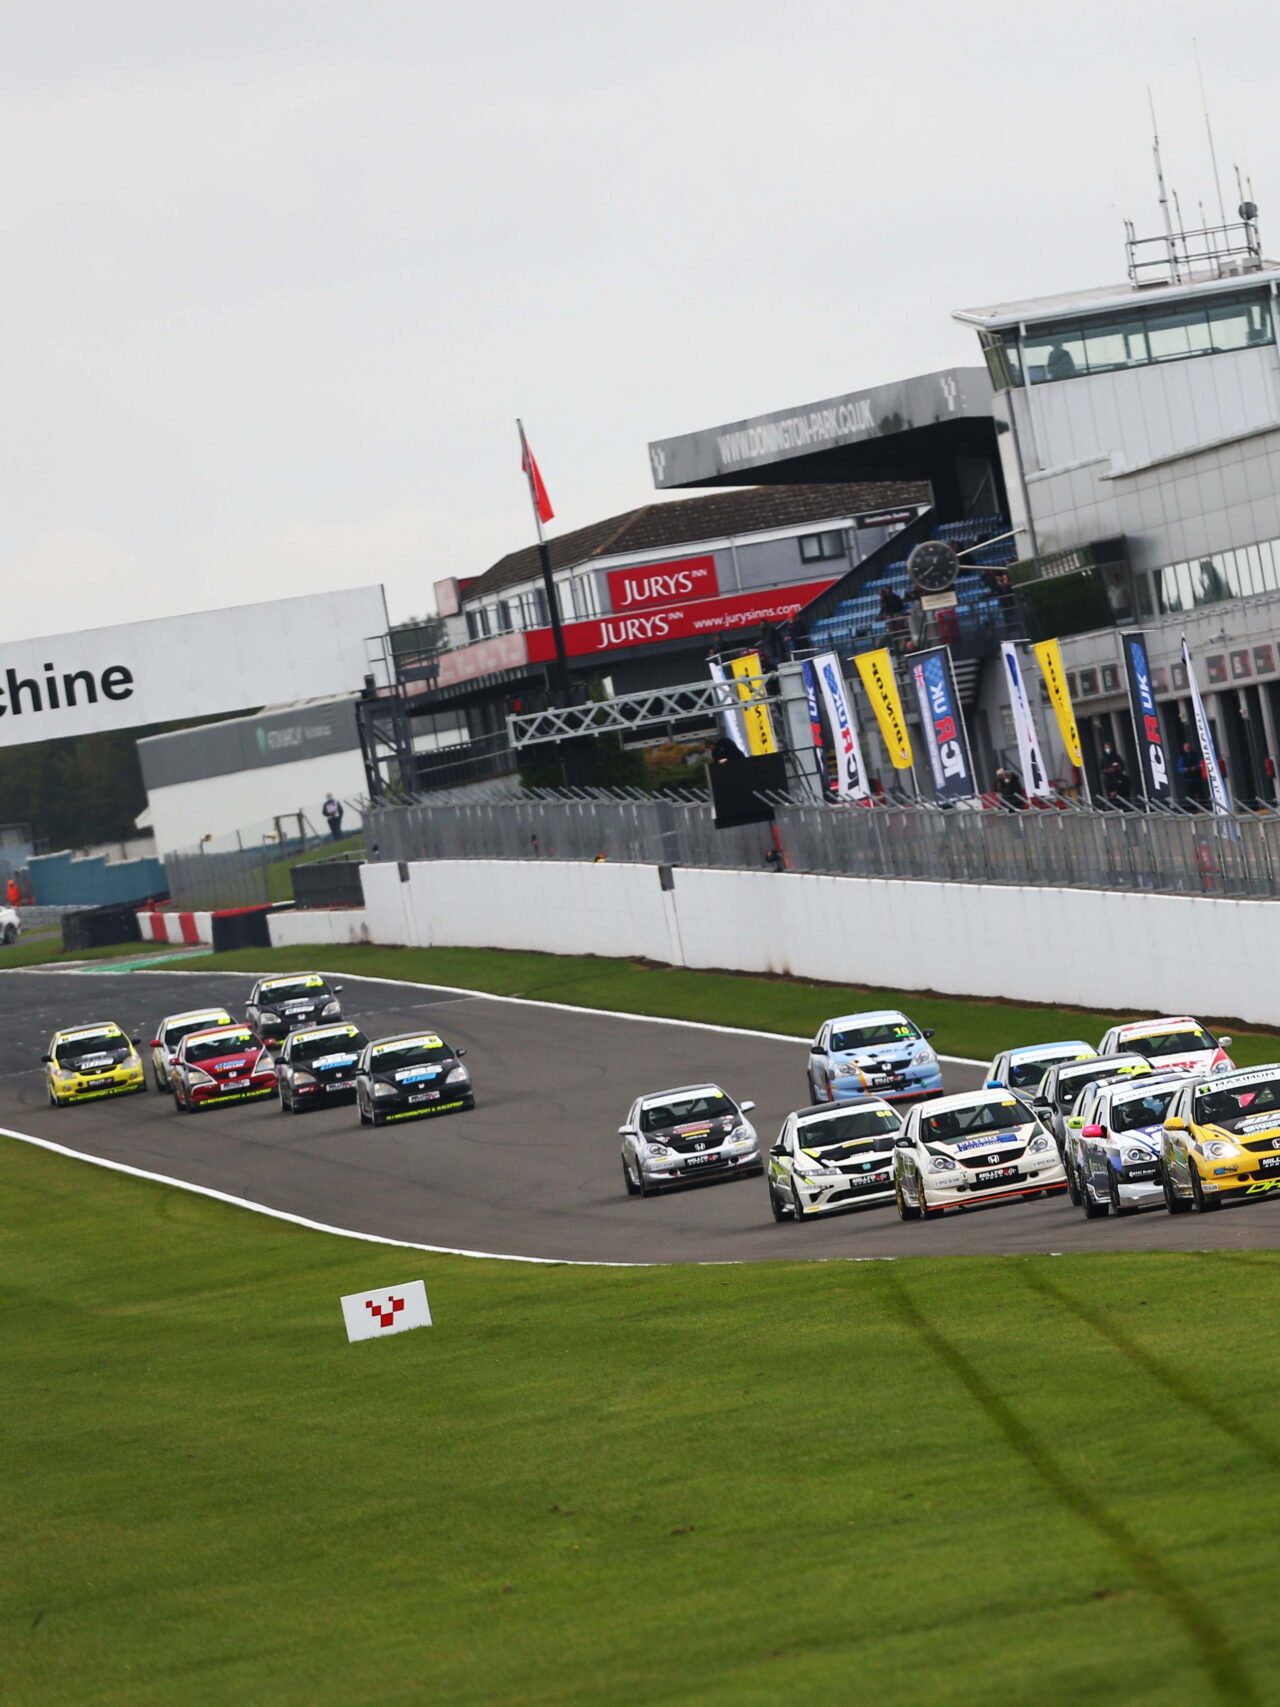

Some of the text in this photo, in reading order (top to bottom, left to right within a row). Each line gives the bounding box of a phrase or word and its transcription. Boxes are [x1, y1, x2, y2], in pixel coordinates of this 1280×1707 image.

[620, 568, 708, 606] JURYS INN
[597, 602, 801, 648] JURYS INN www.jurysinns.com
[0, 662, 134, 719] hine
[1137, 673, 1169, 791] TCR UK
